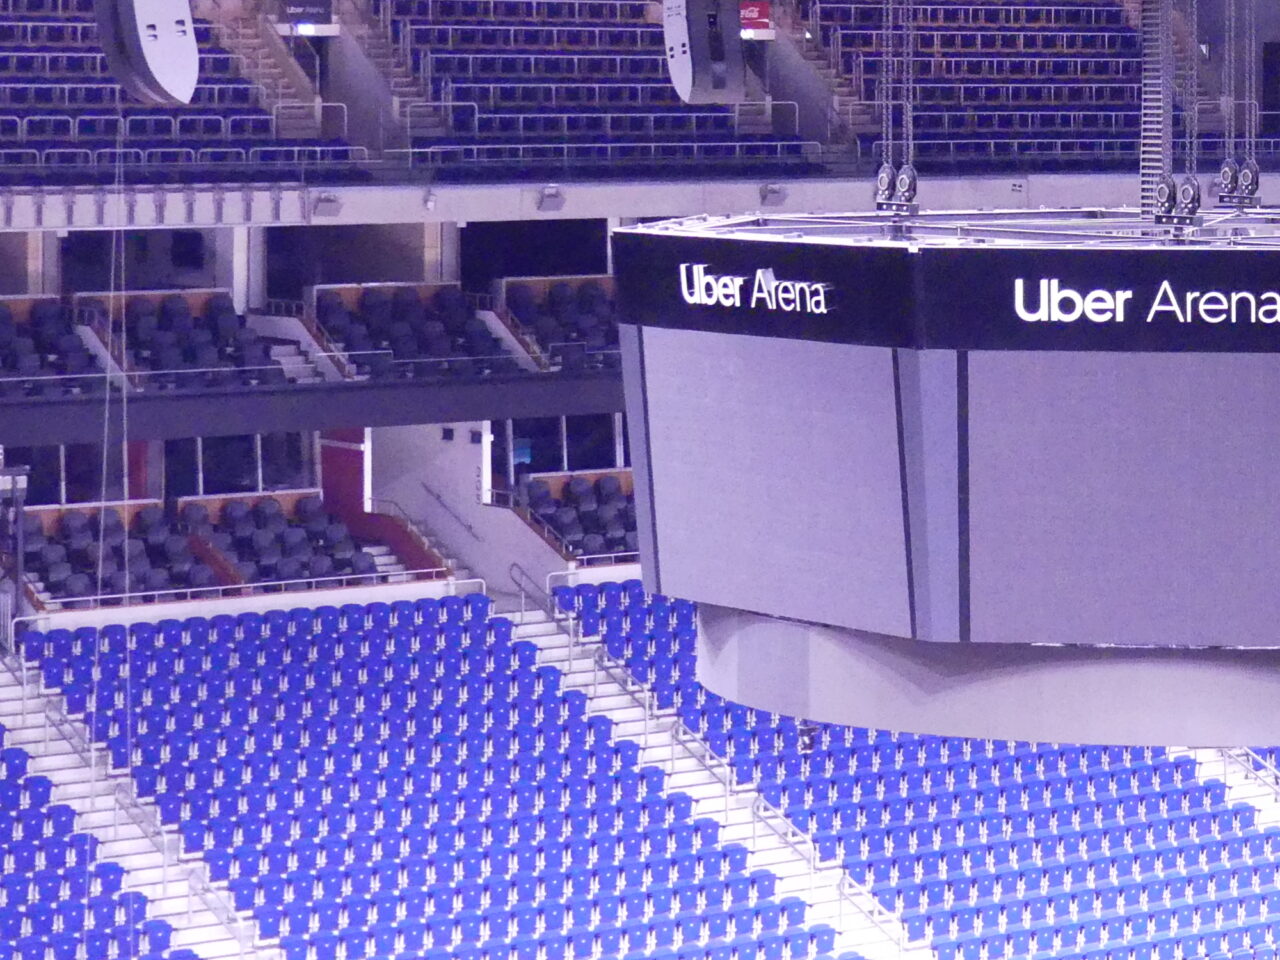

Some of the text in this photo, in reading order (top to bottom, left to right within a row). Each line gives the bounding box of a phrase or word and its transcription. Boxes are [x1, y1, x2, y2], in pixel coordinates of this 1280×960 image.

[679, 263, 829, 314] Uber Arena
[1014, 278, 1133, 323] Uber
